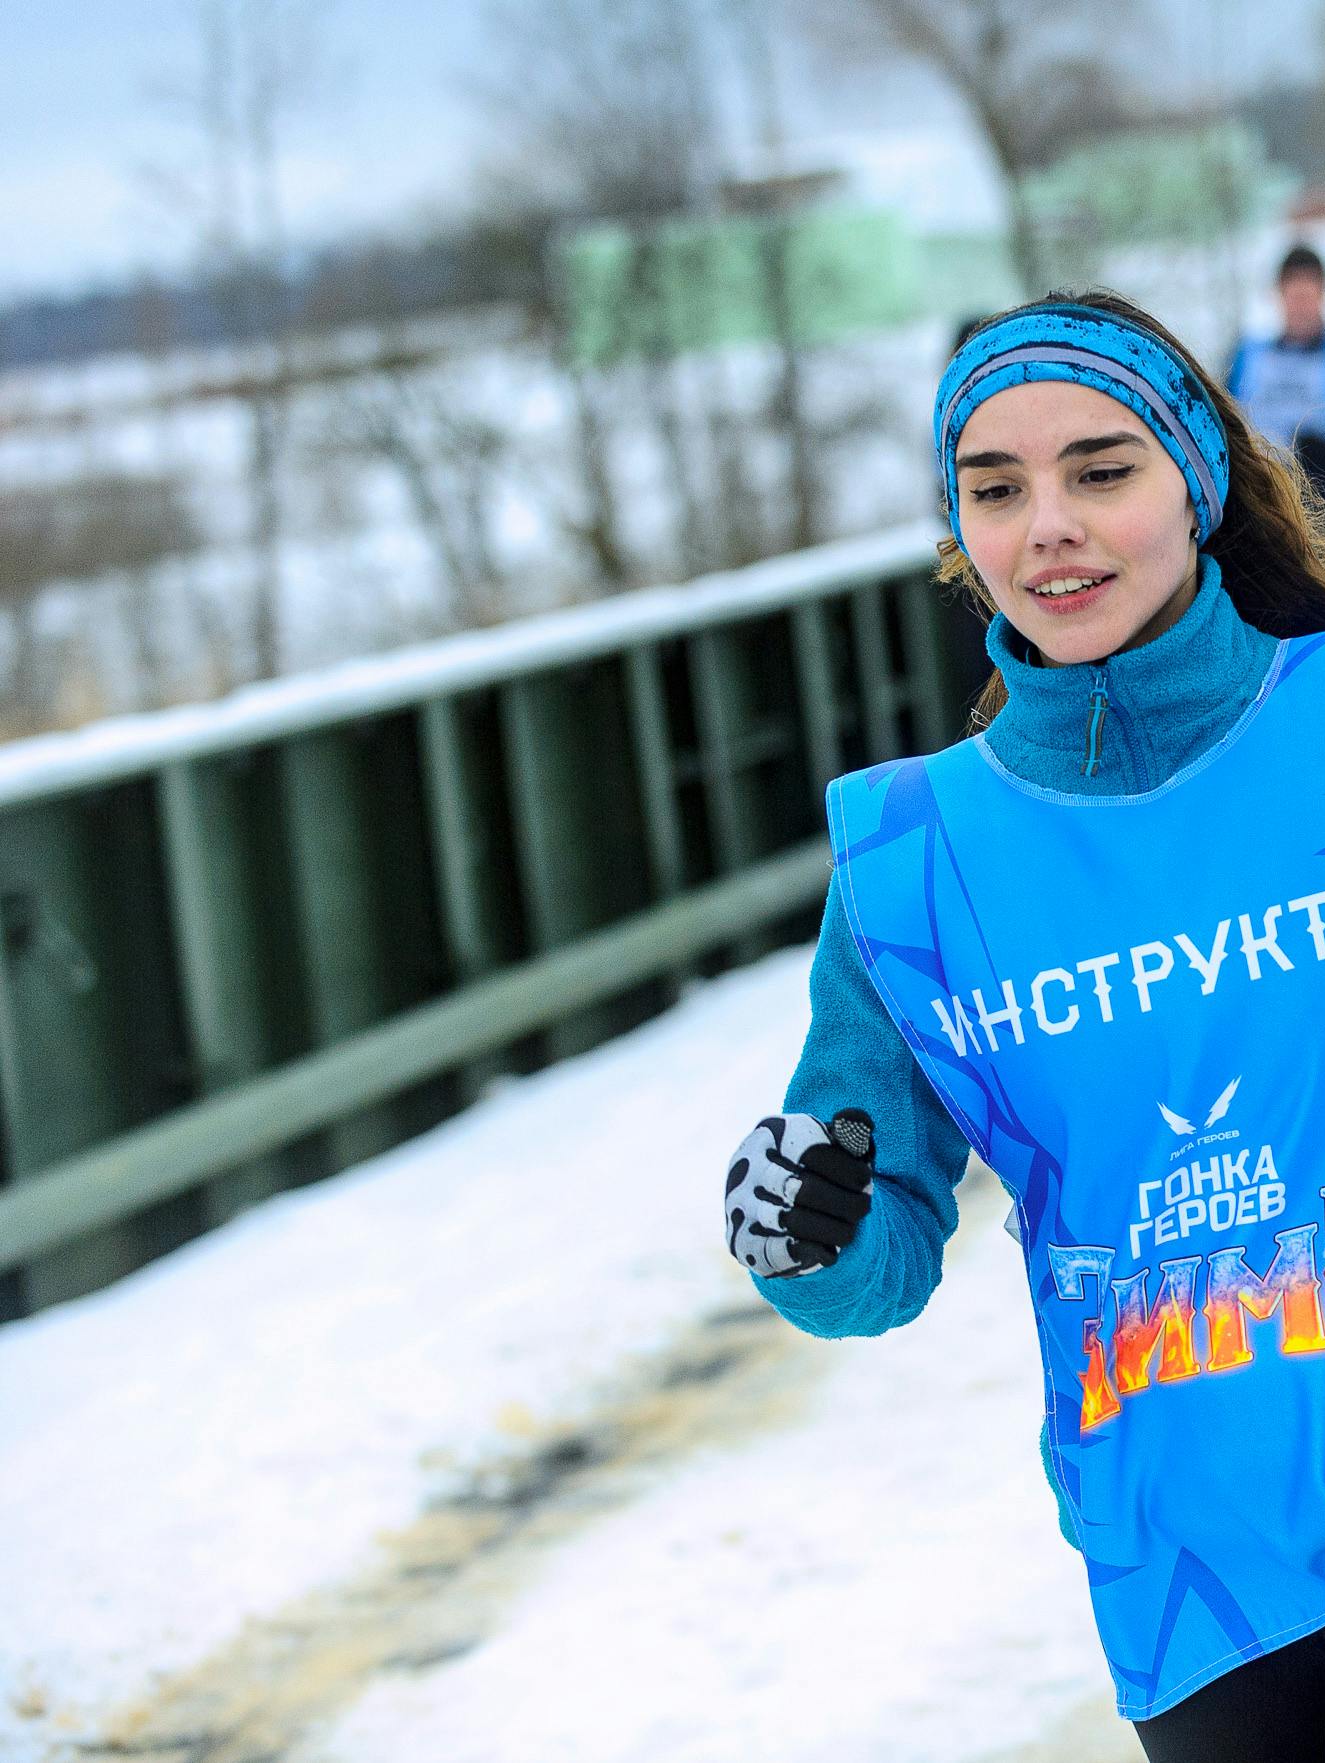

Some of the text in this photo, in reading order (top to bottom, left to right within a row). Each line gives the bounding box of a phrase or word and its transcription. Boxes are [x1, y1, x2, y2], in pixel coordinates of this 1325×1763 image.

[1138, 1144, 1279, 1219] ГОНКА
[1170, 1129, 1240, 1161] ЛИГА ГЕРОЕВ
[1129, 1182, 1286, 1260] ГЕРОЕВ
